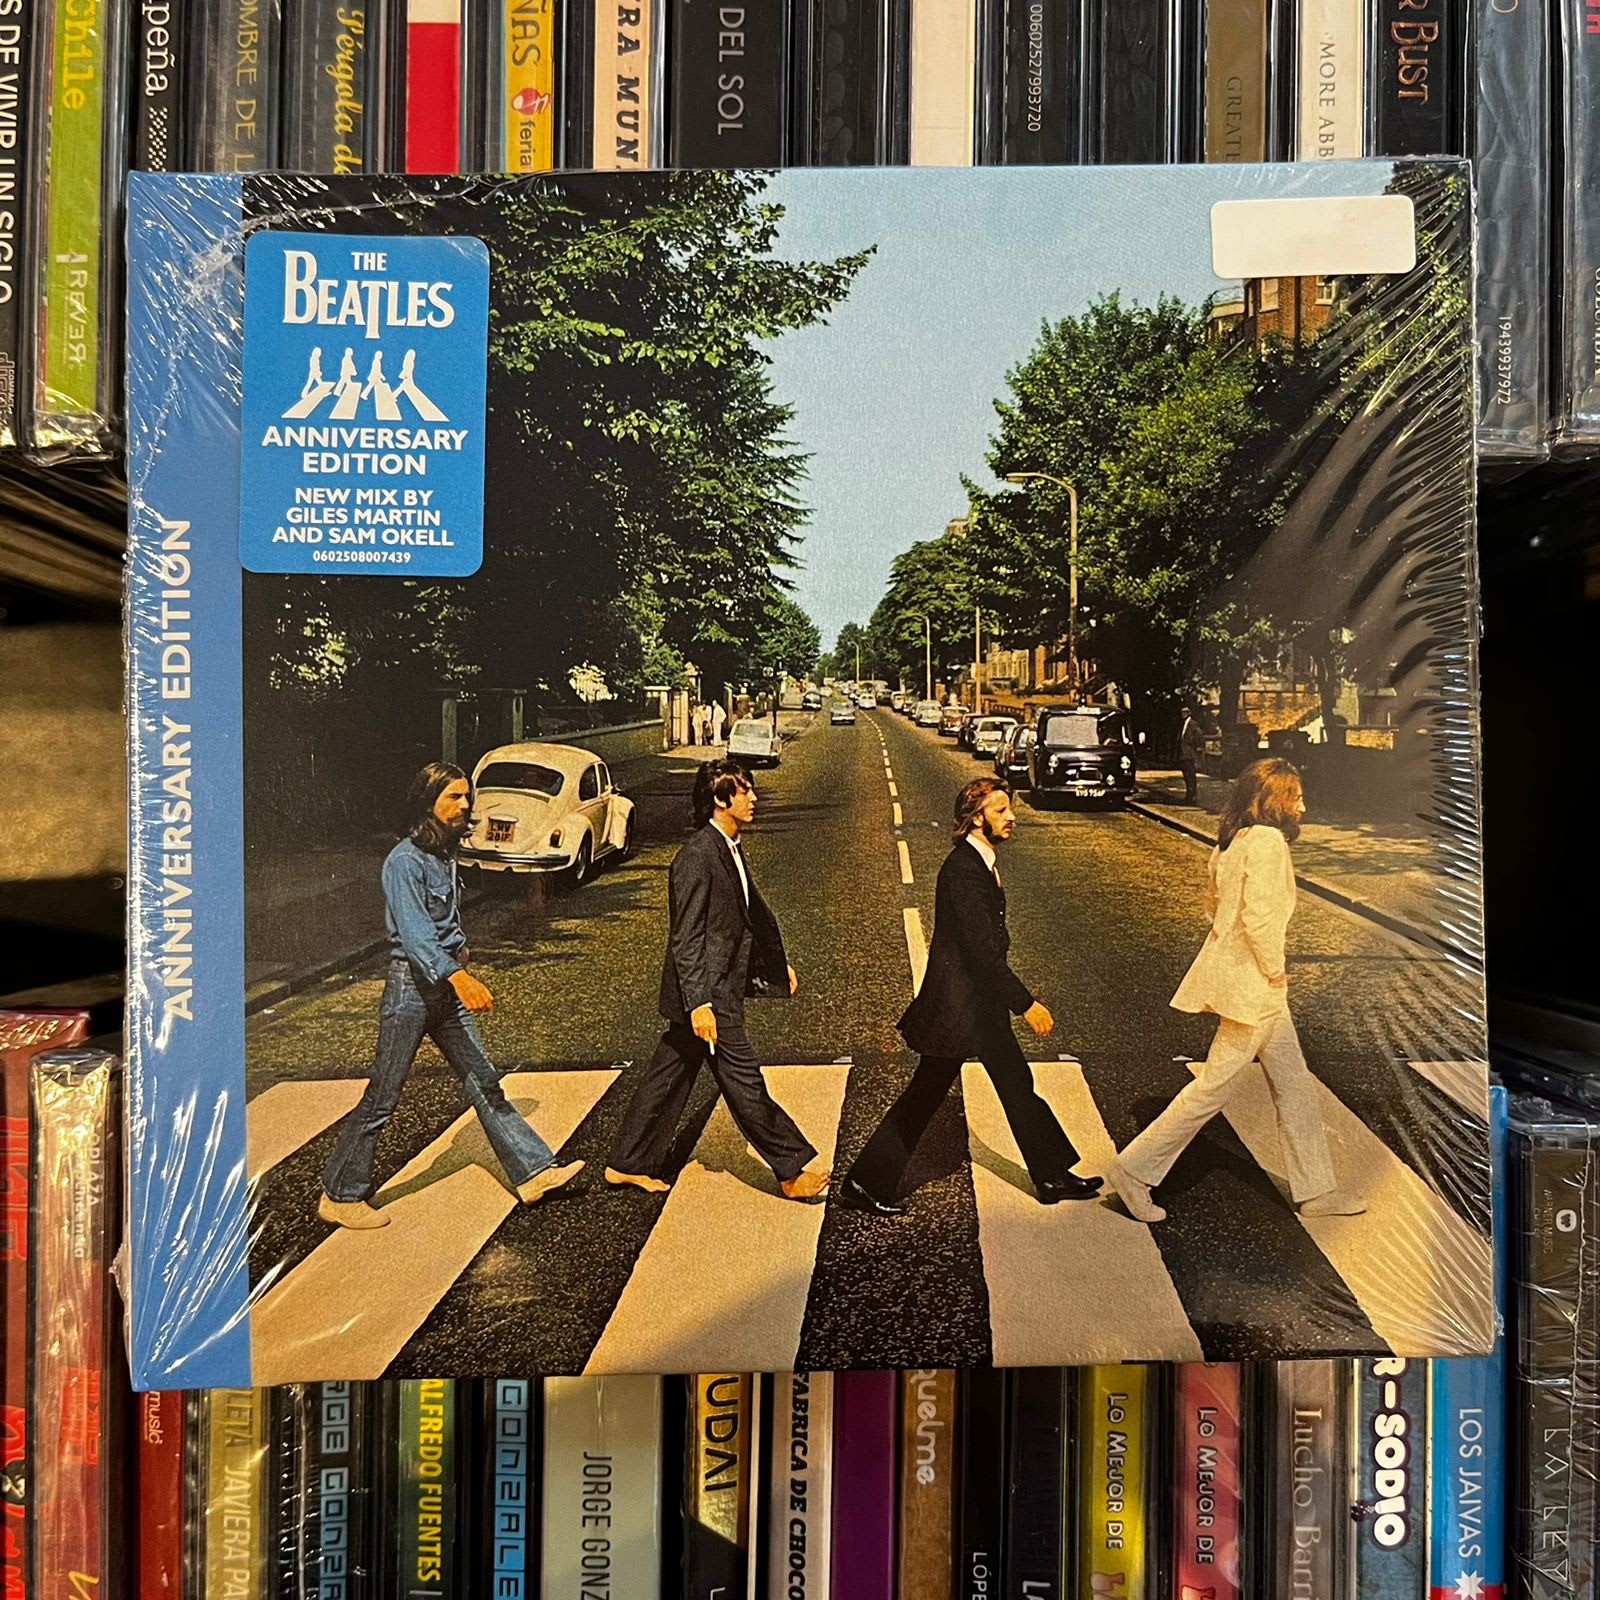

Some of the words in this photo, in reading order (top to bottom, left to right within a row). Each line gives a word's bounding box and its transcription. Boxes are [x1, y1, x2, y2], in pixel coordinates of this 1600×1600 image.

[143, 0, 176, 96] peña
[718, 8, 745, 63] DEL
[1027, 4, 1043, 132] 00602527993720
[235, 100, 257, 141] DE
[616, 75, 640, 169] MUN
[717, 75, 744, 136] SOL
[519, 119, 535, 167] feria
[351, 252, 387, 271] THE
[282, 250, 455, 339] BEATLES
[261, 426, 469, 451] ANNIVERSARY
[302, 453, 427, 475] EDITION
[286, 507, 348, 524] GILES
[354, 508, 441, 526] MARTIN
[295, 488, 351, 505] NEW
[356, 489, 398, 506] MIX
[404, 490, 434, 506] BY
[272, 527, 323, 544] AND
[328, 527, 376, 545] SAM
[381, 528, 454, 546] OKELL
[312, 551, 412, 564] 0602508007439
[161, 520, 192, 699] EDITION
[161, 715, 195, 1021] ANNIVERSARY
[419, 1379, 444, 1478] ALFREDO
[1106, 1393, 1128, 1424] LO
[1197, 1407, 1219, 1438] LO
[1458, 1408, 1483, 1459] LOS
[1106, 1431, 1128, 1513] MEJOR
[1293, 1407, 1324, 1508] Lucho
[223, 1466, 253, 1562] JAVIERA
[582, 1451, 612, 1528] JORGE
[790, 1478, 808, 1513] DE
[1196, 1447, 1218, 1527] MEJOR
[1458, 1467, 1483, 1559] JAIVAS
[417, 1483, 443, 1582] FUENTES
[1105, 1520, 1124, 1550] DE
[1196, 1535, 1215, 1564] DE
